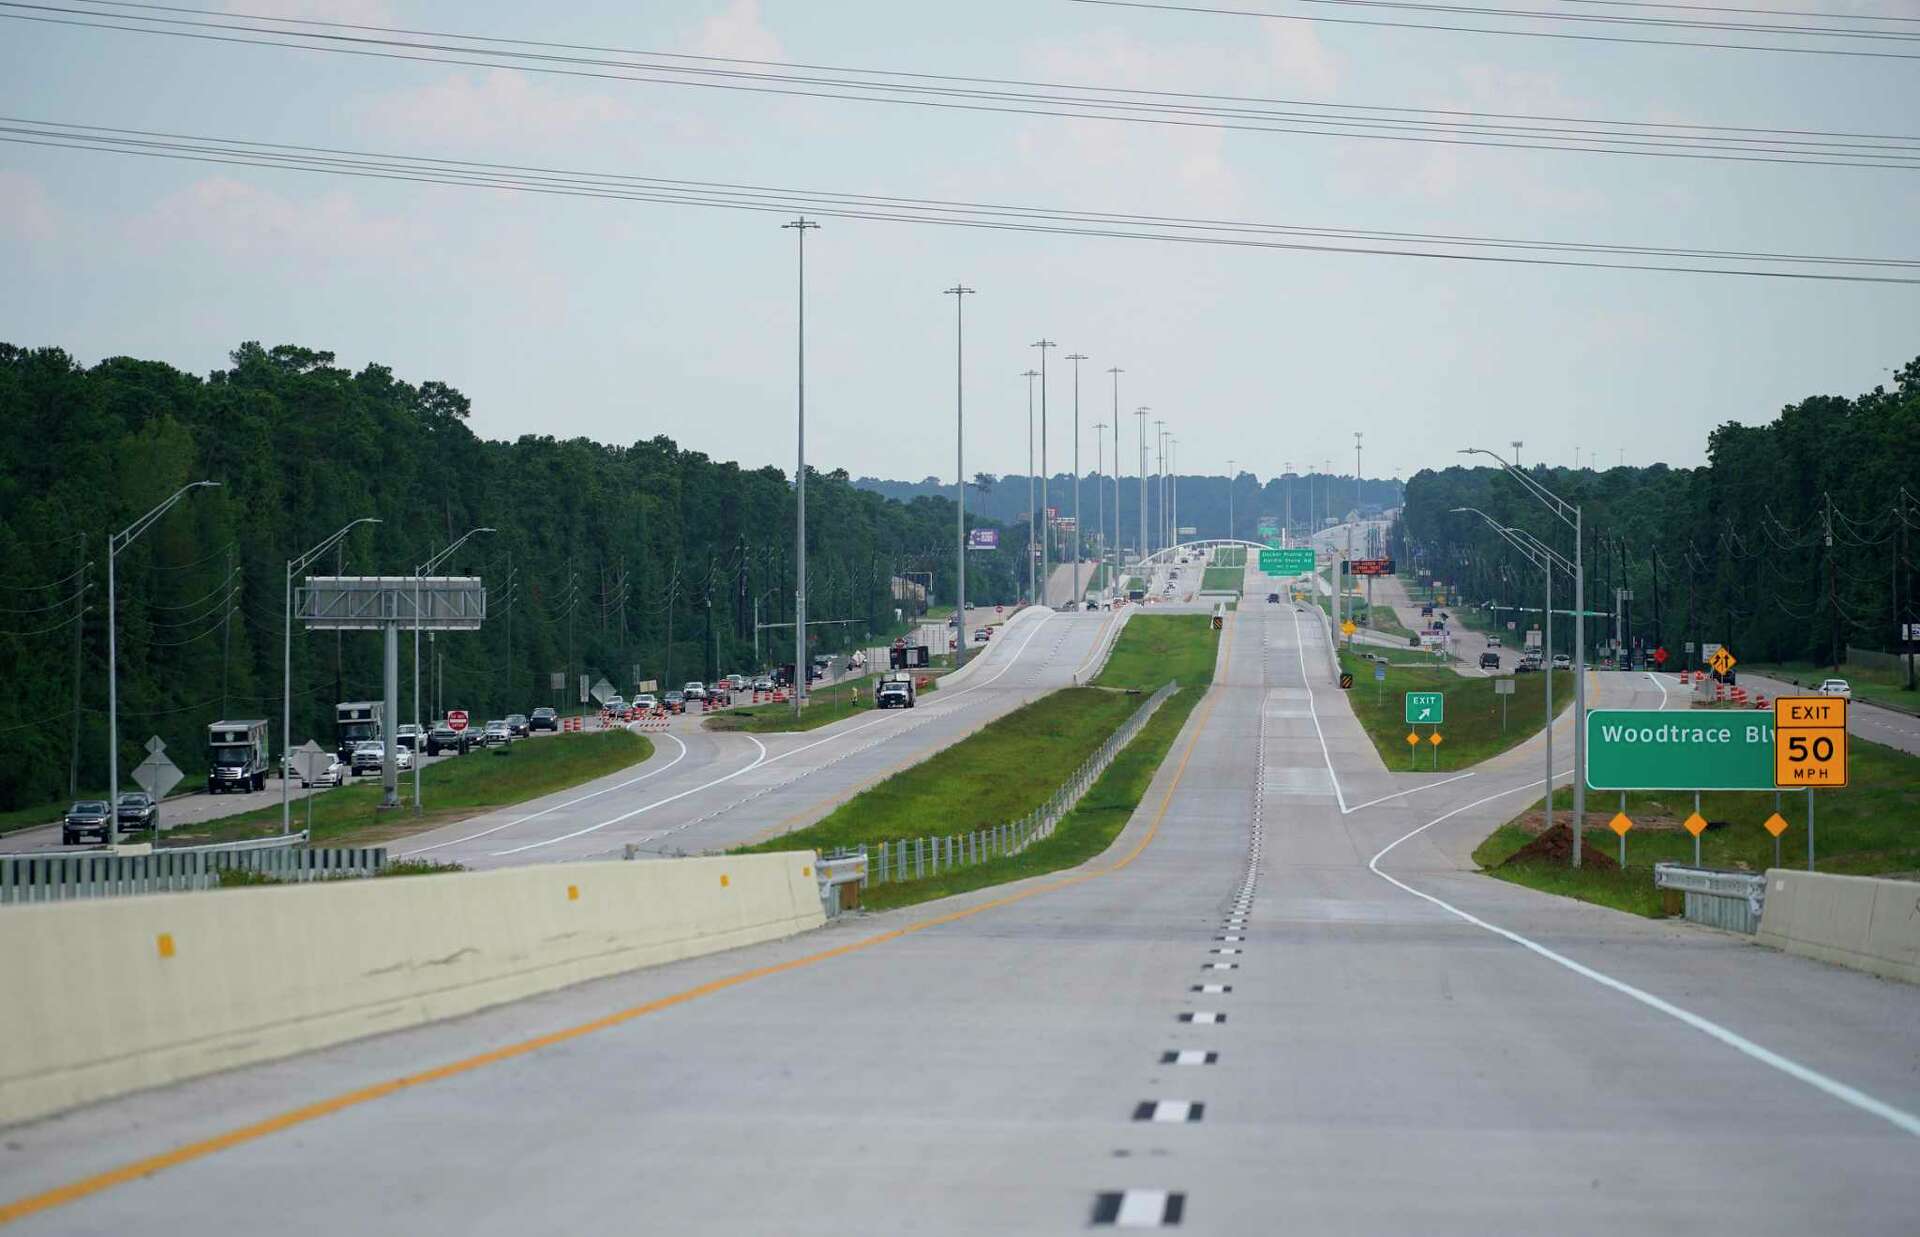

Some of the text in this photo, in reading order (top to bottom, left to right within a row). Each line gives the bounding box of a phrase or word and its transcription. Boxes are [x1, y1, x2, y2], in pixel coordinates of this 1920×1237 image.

[1413, 696, 1436, 704] EXIT
[1791, 706, 1830, 719] EXIT
[1602, 724, 1730, 743] Woodtrace
[1789, 736, 1834, 762] 50
[1794, 768, 1828, 779] MPH
